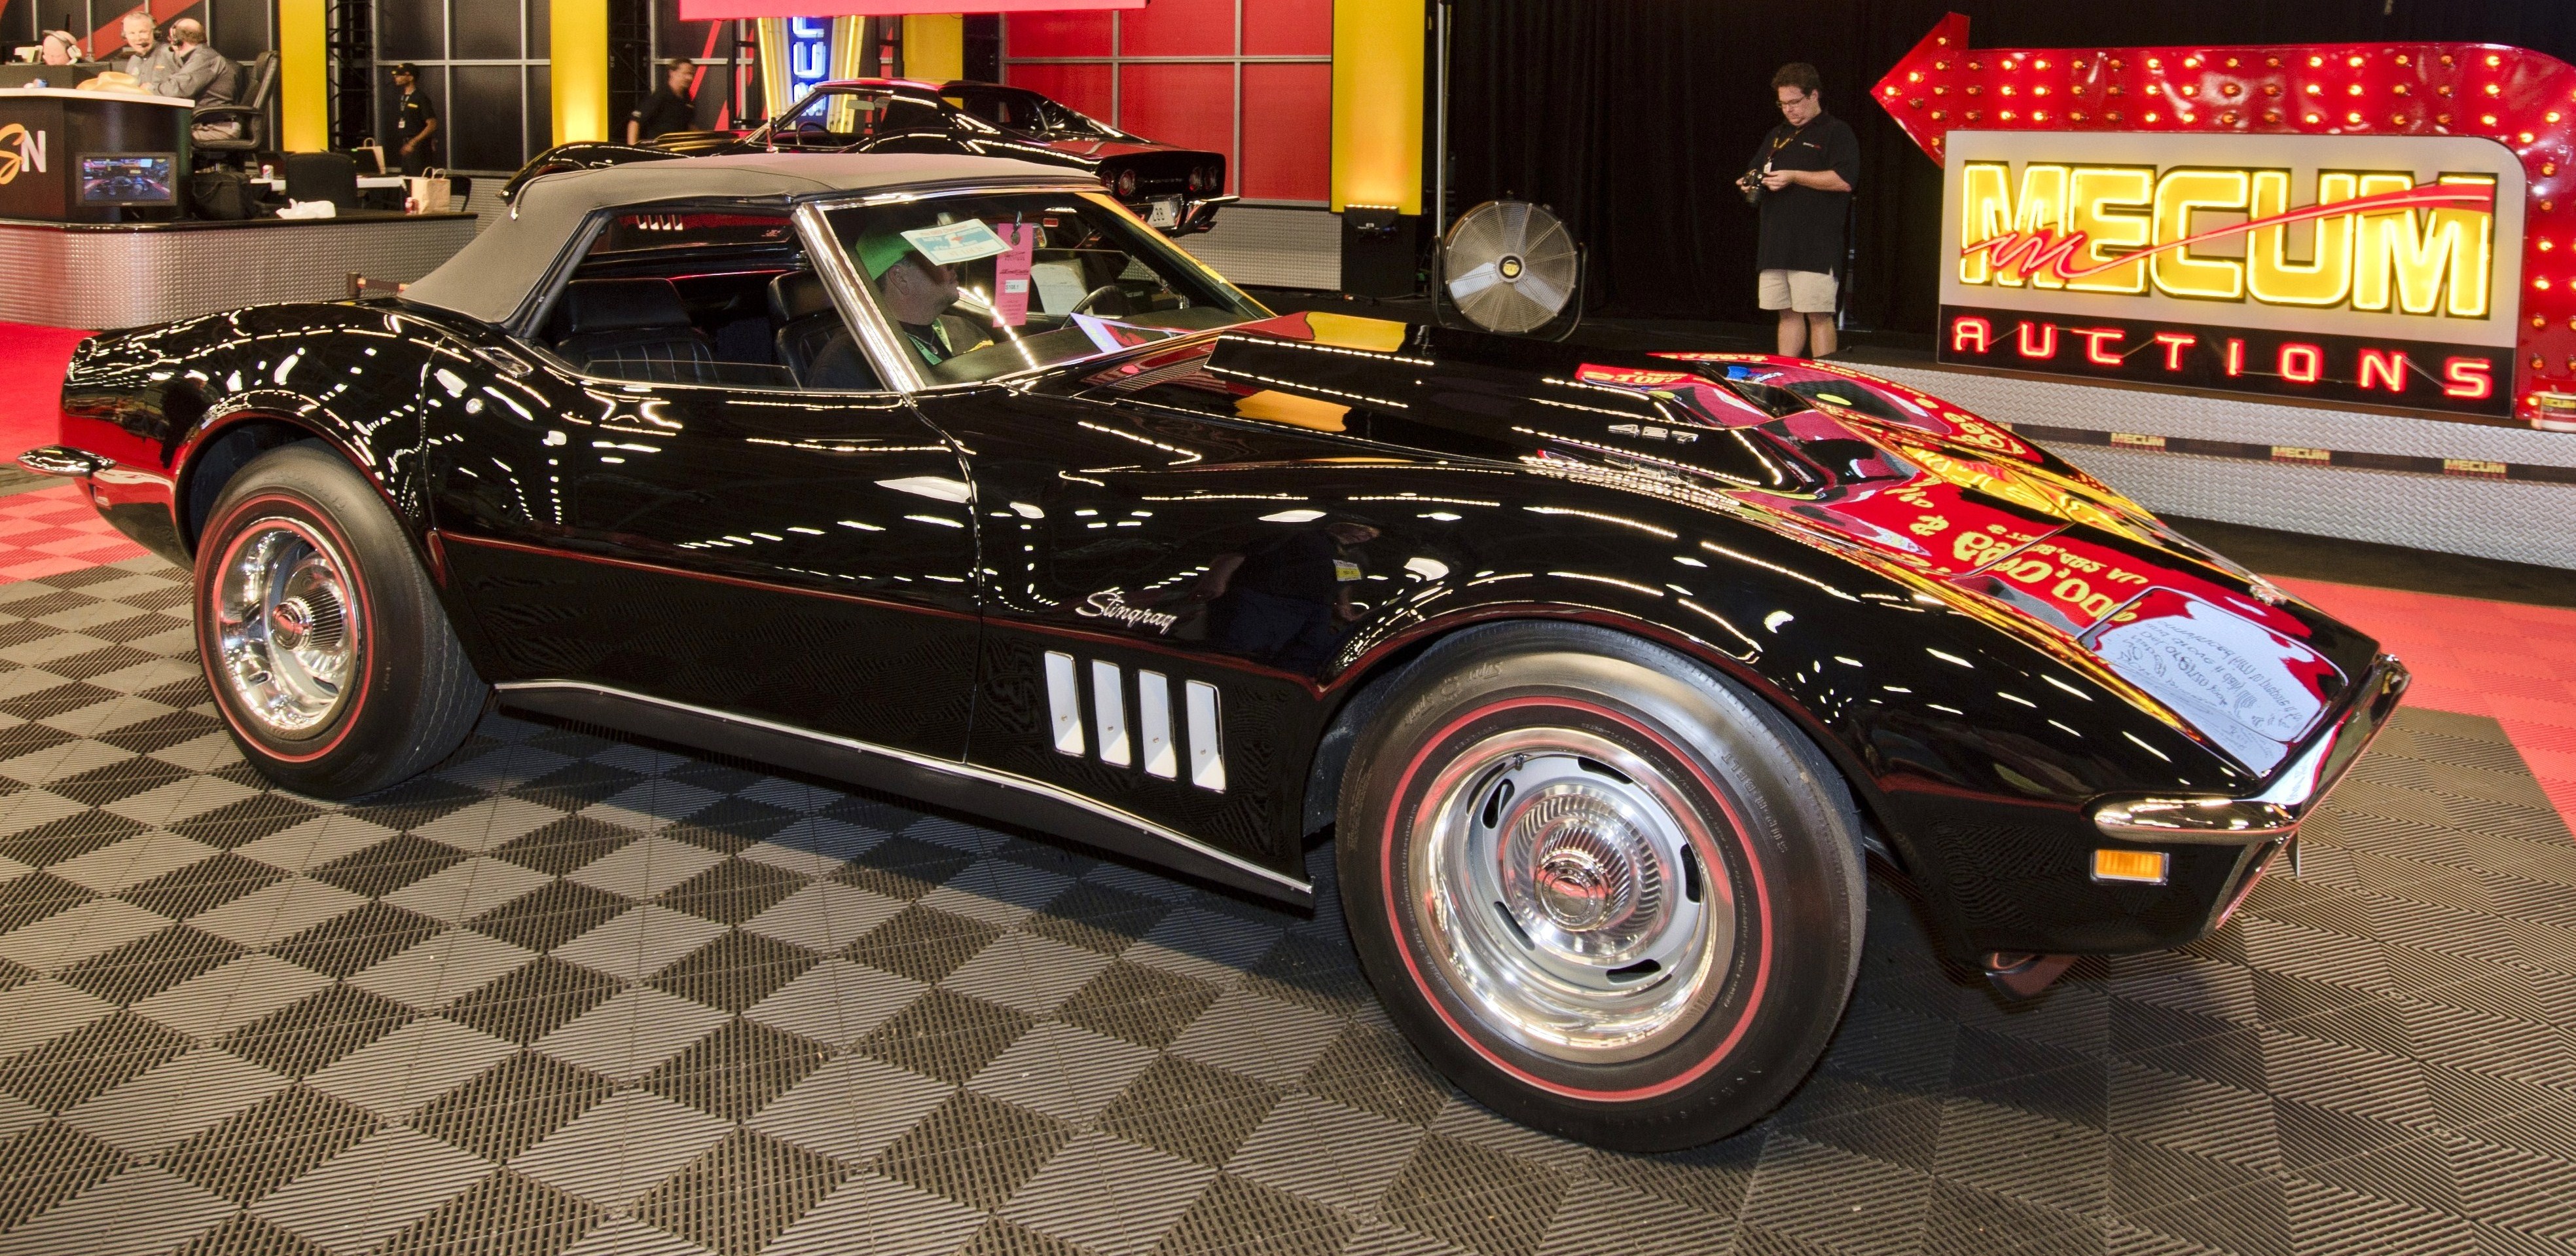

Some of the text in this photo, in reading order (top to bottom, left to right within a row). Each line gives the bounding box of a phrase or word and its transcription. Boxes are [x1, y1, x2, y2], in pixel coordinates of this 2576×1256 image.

[1959, 160, 2498, 320] MECUM
[1953, 318, 2494, 399] AUCTIONS
[2111, 433, 2165, 447] MECUM
[2272, 446, 2331, 460] MECUM
[2444, 459, 2506, 473] MECUM
[1075, 591, 1178, 635] Stingray
